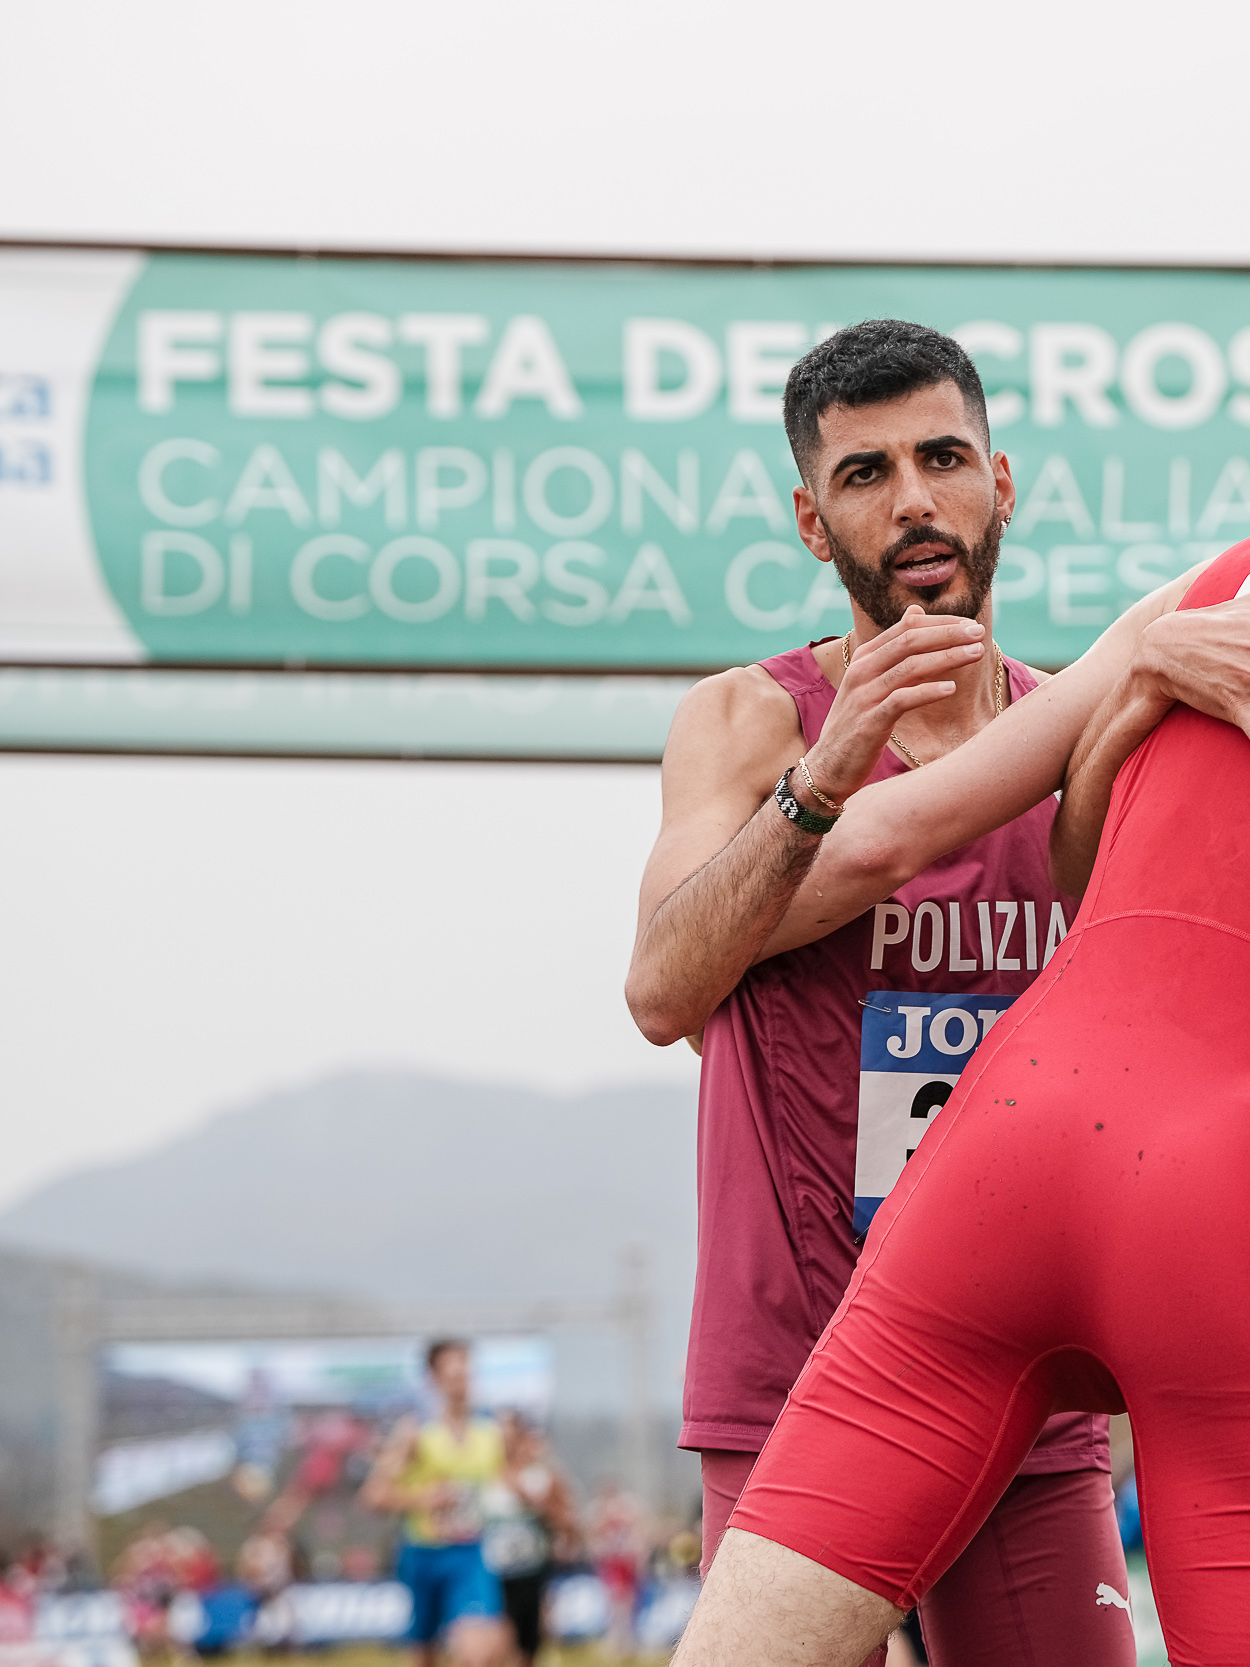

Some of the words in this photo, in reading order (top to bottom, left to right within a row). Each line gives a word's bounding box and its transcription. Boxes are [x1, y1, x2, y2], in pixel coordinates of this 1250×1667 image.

[136, 310, 584, 421] FESTA
[622, 316, 808, 424] DE
[136, 437, 796, 540] CAMPIONA
[140, 529, 254, 617] DI
[289, 532, 693, 628] CORSA
[869, 900, 1069, 973] POLIZIA
[886, 1005, 1009, 1059] Jo
